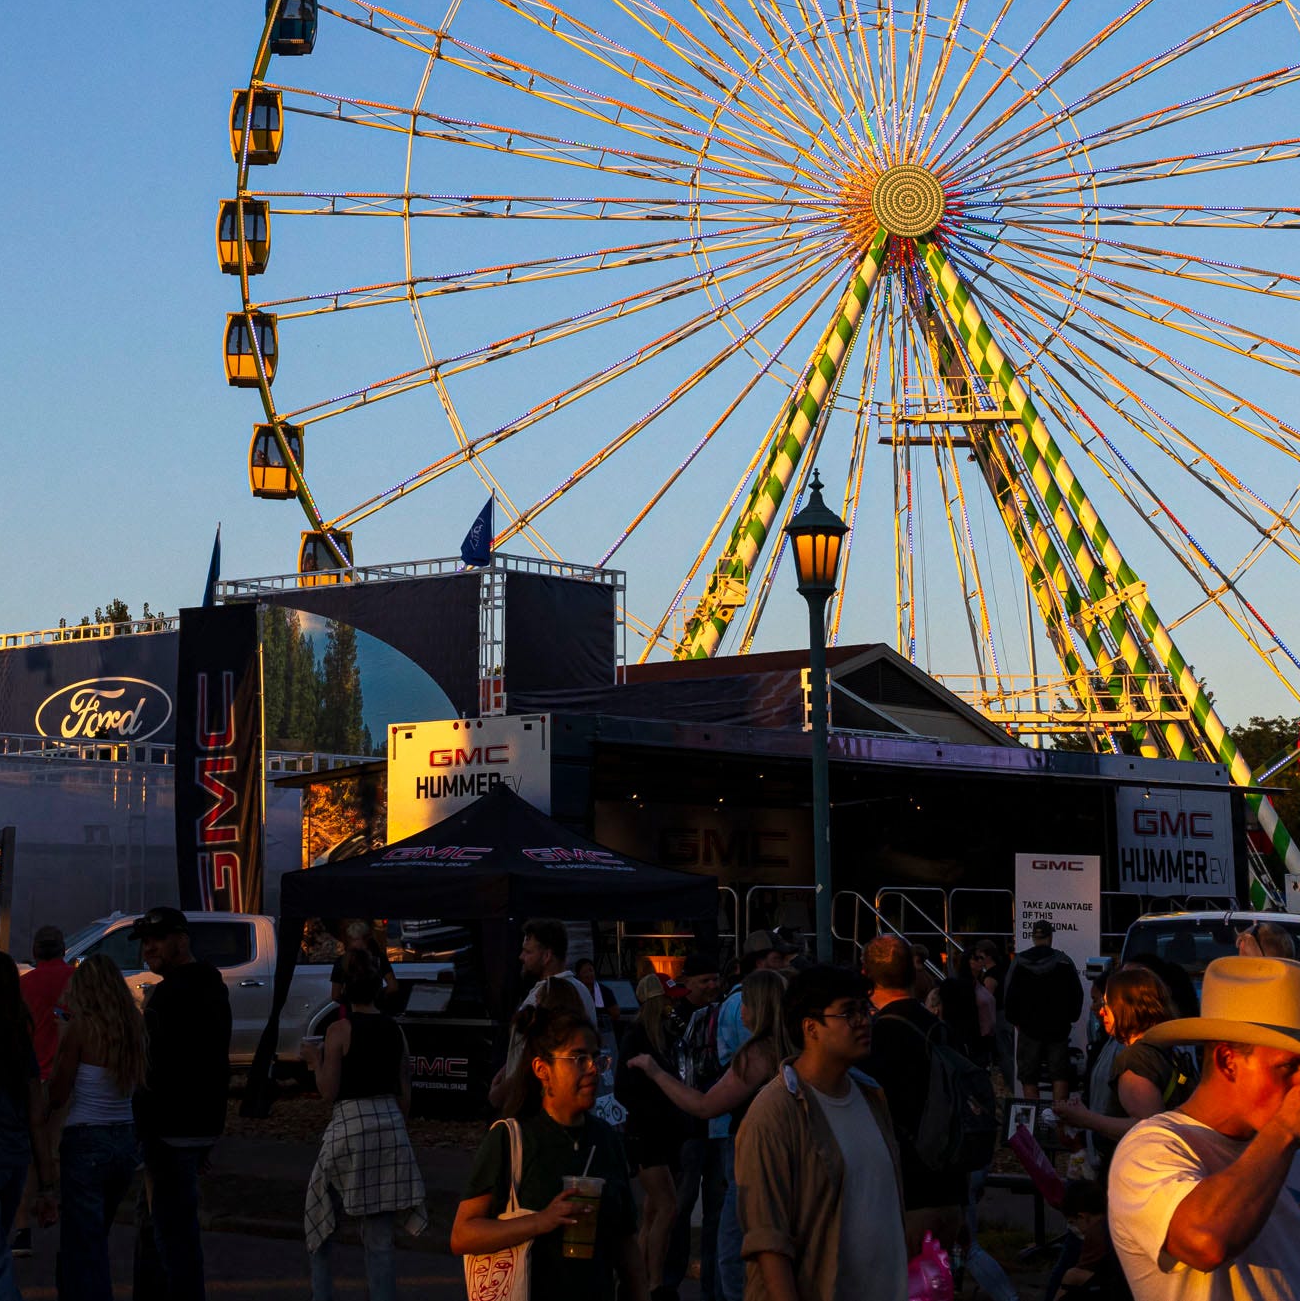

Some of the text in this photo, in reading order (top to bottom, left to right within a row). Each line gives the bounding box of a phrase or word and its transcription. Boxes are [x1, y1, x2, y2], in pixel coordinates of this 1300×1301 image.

[60, 687, 146, 740] Ford
[430, 744, 510, 767] GMC
[195, 671, 243, 913] GMC
[416, 772, 501, 799] HUMMER
[1133, 809, 1215, 839] GMC
[381, 846, 493, 861] GMC
[522, 847, 625, 865] GMC
[659, 828, 789, 868] GMC
[1032, 860, 1084, 871] GMC
[1121, 848, 1229, 885] HUMMER EV
[1022, 901, 1093, 911] TAKE ADVANTAGE
[1022, 911, 1033, 919] OF
[409, 1056, 468, 1077] MC
